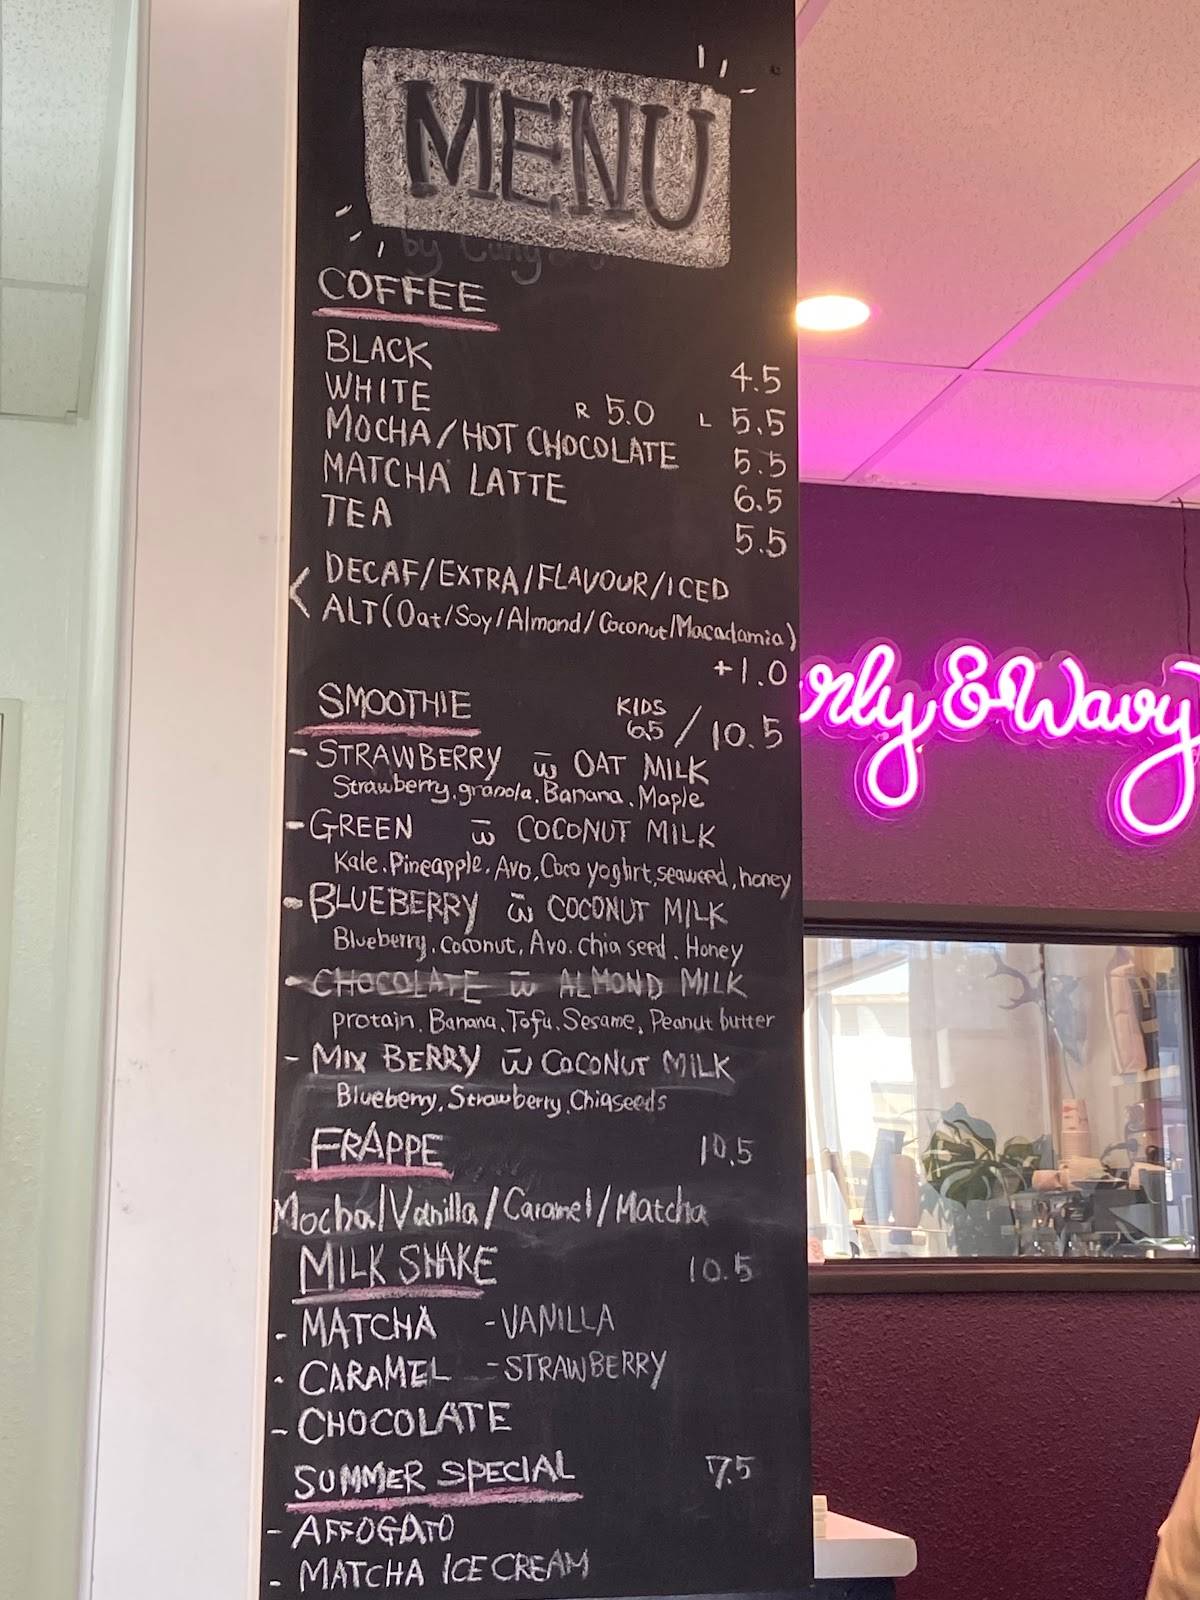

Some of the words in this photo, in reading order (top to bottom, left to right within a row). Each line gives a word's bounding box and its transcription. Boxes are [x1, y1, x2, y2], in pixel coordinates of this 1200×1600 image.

[400, 79, 716, 231] MENU
[318, 267, 488, 312] COFFEE
[326, 329, 432, 370] BLACK
[325, 371, 430, 411] WHITE
[730, 362, 781, 394] 4.5
[575, 402, 590, 418] R
[605, 394, 655, 426] 5.0
[700, 413, 712, 427] L
[732, 407, 785, 436] 5.5
[527, 426, 679, 469] CHOCOLATE
[734, 448, 786, 477] 5.5
[324, 449, 450, 494] MATCHA
[470, 462, 567, 504] LATTE
[321, 494, 392, 528] TEA
[734, 485, 782, 513] 6.5
[736, 523, 786, 558] 5.5
[318, 682, 472, 719] SMOOTHIE
[617, 697, 667, 716] KIDS
[712, 715, 783, 750] 10.5
[798, 644, 936, 806] rly
[998, 655, 1200, 835] Wavy
[316, 739, 501, 780] STRAWBERRY
[574, 750, 626, 777] OAT
[643, 753, 709, 785] MILK
[639, 785, 705, 814] Maple
[310, 808, 413, 844] GREEN
[517, 815, 631, 844] COCONUT
[648, 819, 716, 848] MILK
[540, 852, 581, 878] Coco
[739, 865, 792, 900] honey
[309, 882, 479, 936] BLUEBERRY
[548, 894, 650, 925] COCONUT
[664, 897, 729, 930] MILK
[686, 933, 744, 968] Honey
[313, 967, 488, 1004] CHOCOLATE
[559, 966, 664, 1000] ALMOND
[680, 967, 748, 999] MILK
[650, 1008, 714, 1034] Peanut
[719, 1006, 776, 1031] butter
[383, 1043, 481, 1079] BERRY
[541, 1049, 650, 1077] COCONUT
[662, 1049, 736, 1084] MILK
[310, 1121, 444, 1171] FRAPPE
[700, 1132, 754, 1167] 10.5
[301, 1241, 386, 1295] MILK
[399, 1240, 498, 1286] SHAKE
[688, 1251, 753, 1283] 10.5
[302, 1304, 438, 1350] MATCHA
[299, 1353, 453, 1396] CARAMEL
[298, 1400, 512, 1445] CHOCOLATE
[293, 1460, 426, 1499] SUMMER
[437, 1449, 576, 1495] SPECIAL
[705, 1455, 755, 1490] 7.5
[291, 1512, 455, 1549] AFFOGATO
[300, 1556, 425, 1593] MATCHA
[442, 1552, 488, 1585] ICE
[491, 1548, 590, 1582] CREAM
